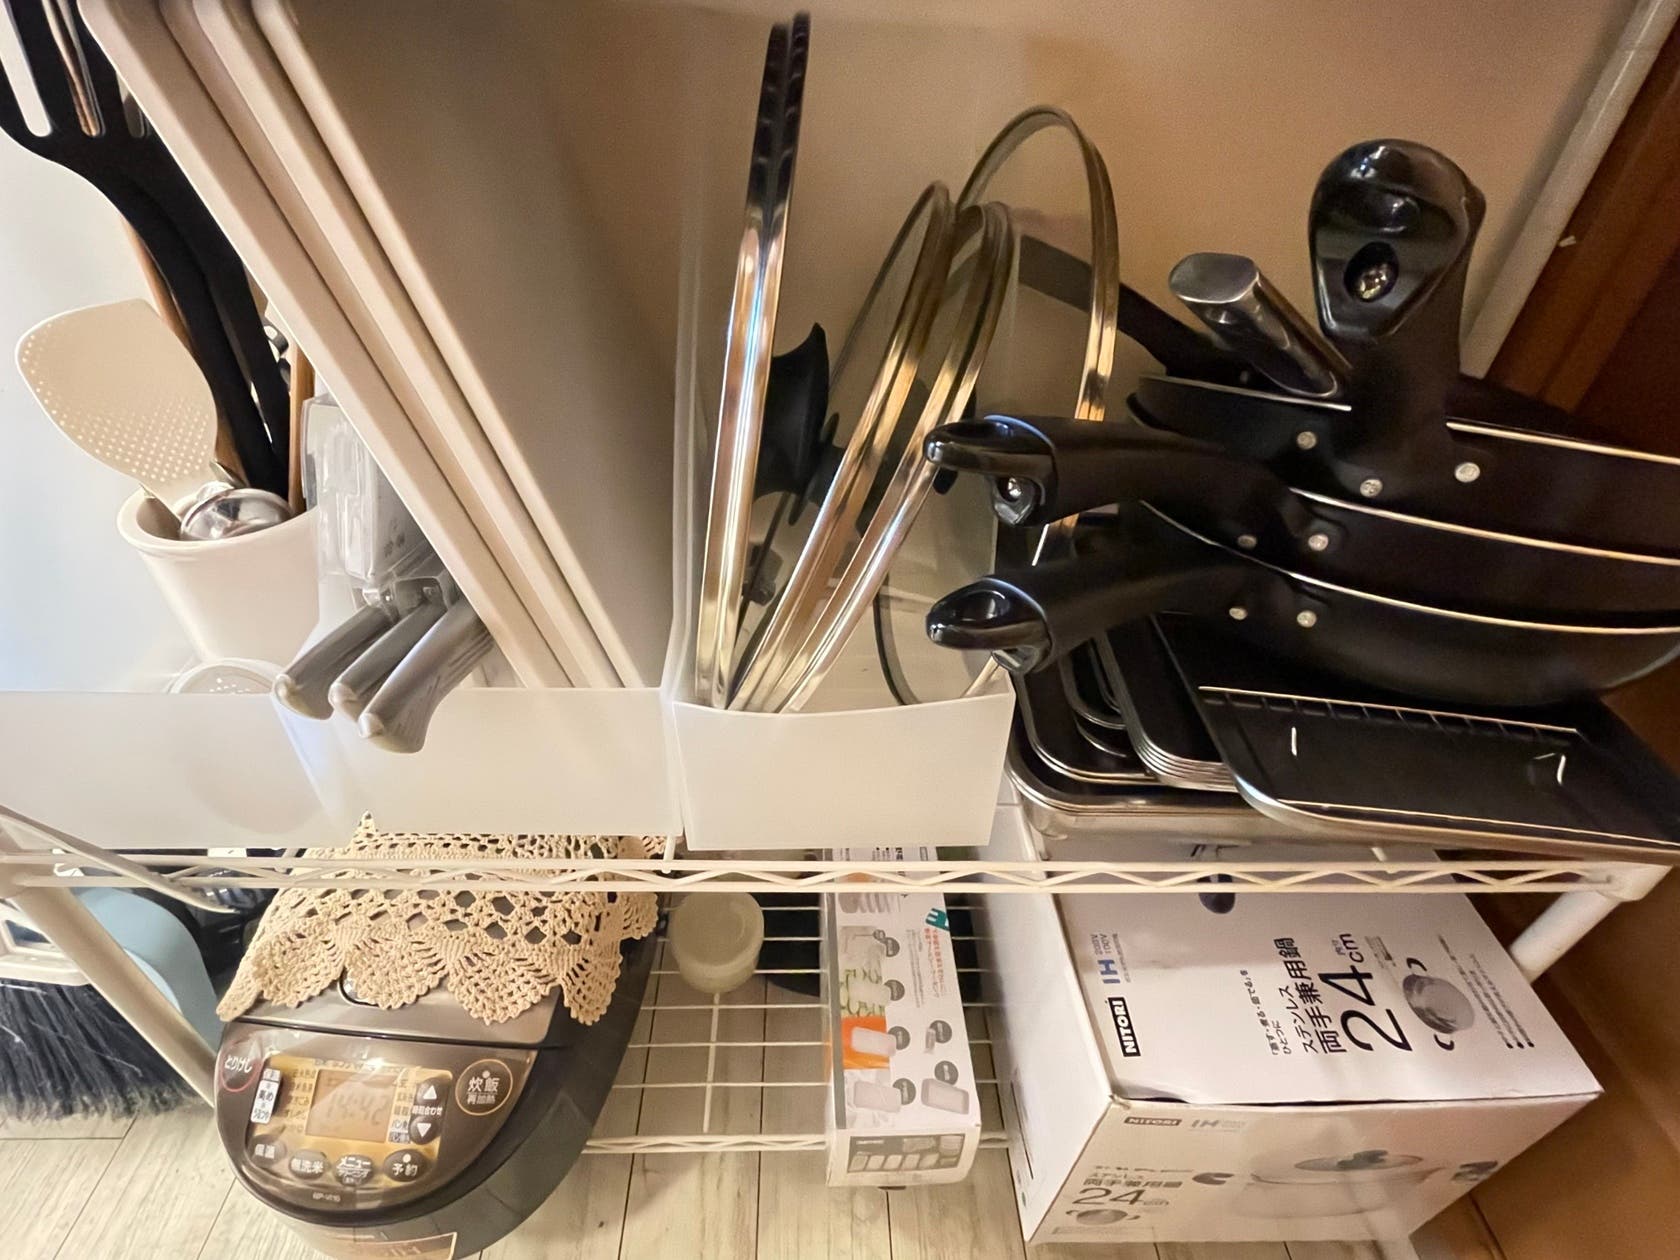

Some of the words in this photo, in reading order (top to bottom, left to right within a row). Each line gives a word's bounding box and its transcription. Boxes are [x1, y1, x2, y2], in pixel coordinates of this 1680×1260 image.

[1098, 958, 1120, 984] IH
[1274, 937, 1348, 1054] 両手兼用鍋
[1112, 1000, 1138, 1055] NITORI
[1278, 985, 1319, 1054] ステンレス
[1271, 1019, 1292, 1055] ひとつに
[224, 1055, 253, 1074] とりけし
[467, 1076, 500, 1092] 炊飯
[1127, 1117, 1181, 1126] NITORI
[338, 1156, 372, 1167] メニュー
[392, 1163, 418, 1176] 予約
